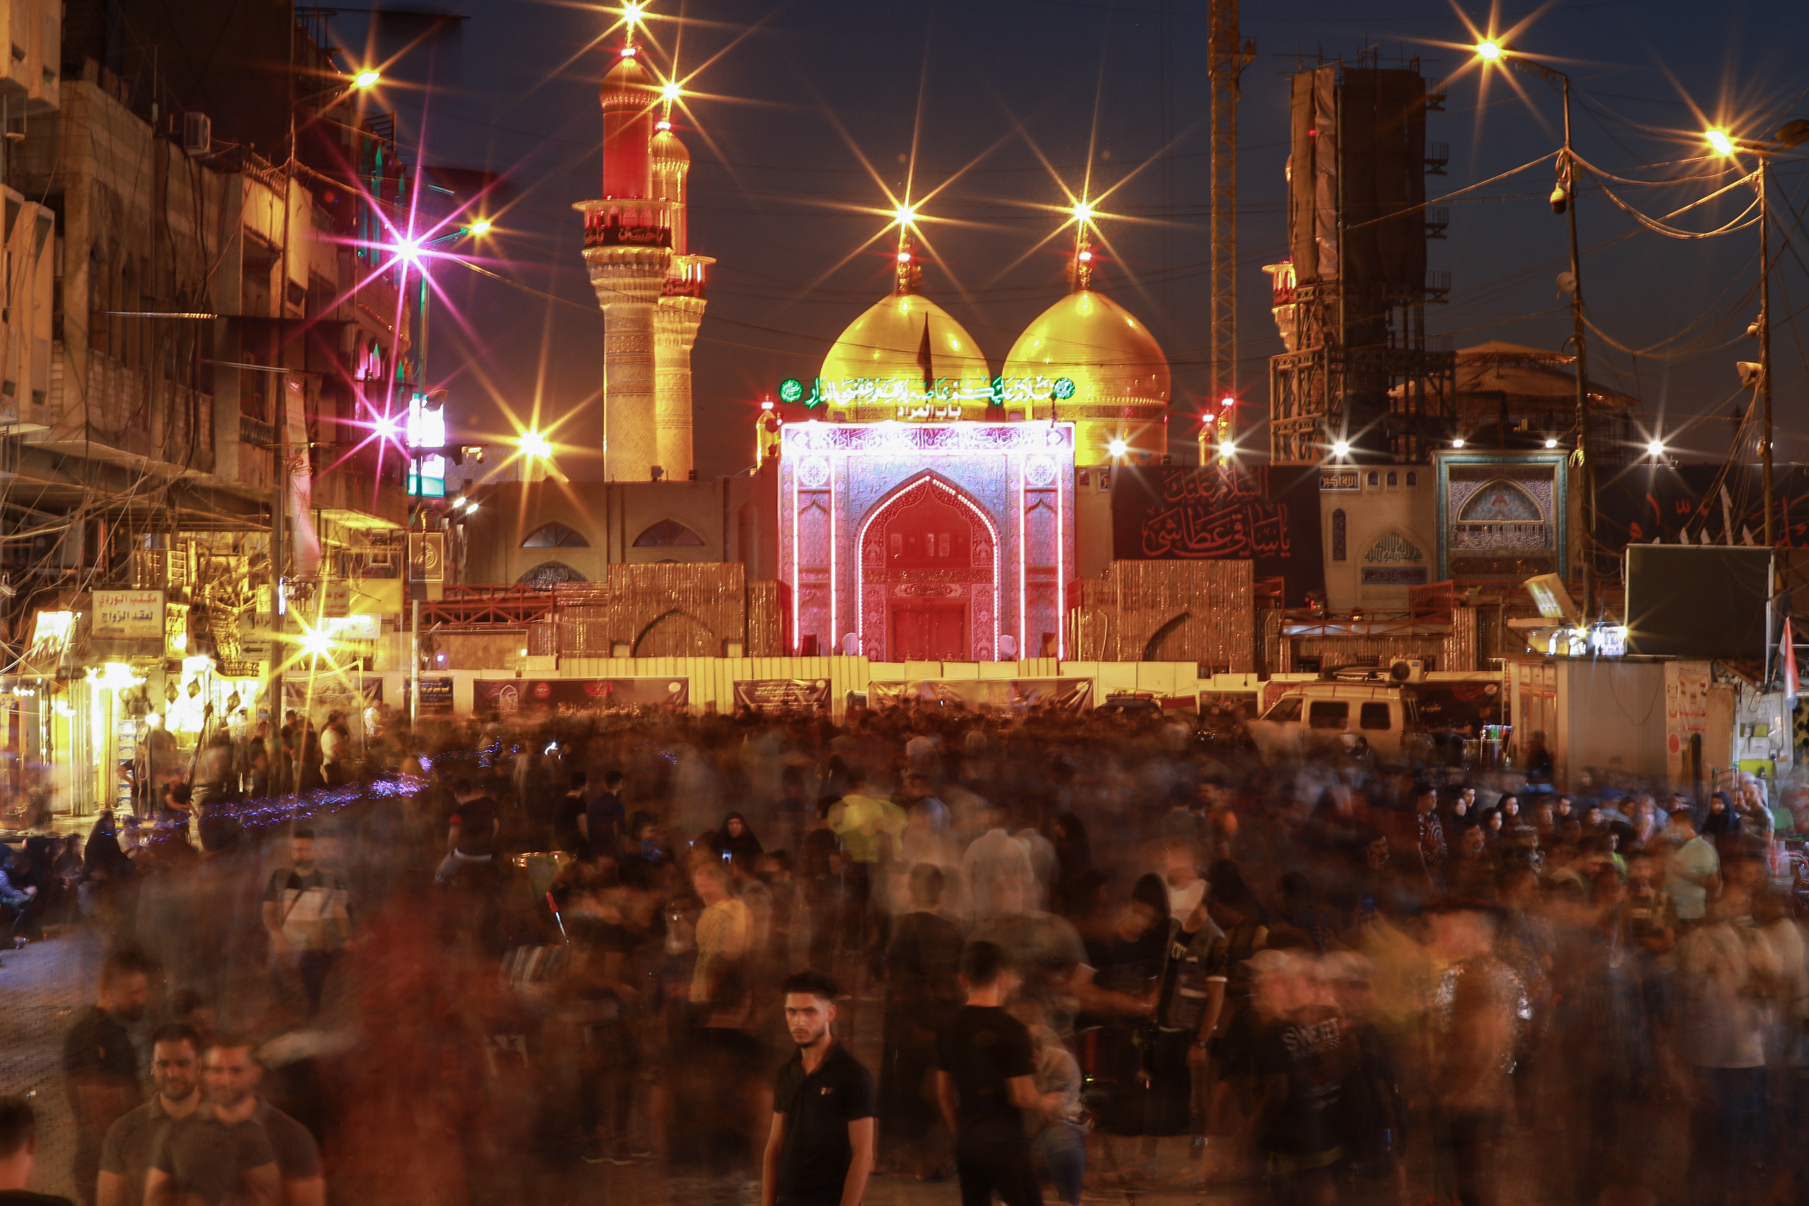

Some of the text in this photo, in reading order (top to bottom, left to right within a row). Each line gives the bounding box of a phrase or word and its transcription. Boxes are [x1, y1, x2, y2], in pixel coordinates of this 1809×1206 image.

[897, 403, 962, 419] باب المراد
[1164, 466, 1269, 503] السلام عليك
[130, 593, 157, 605] مكتب
[102, 610, 154, 623] لعقد الزواج
